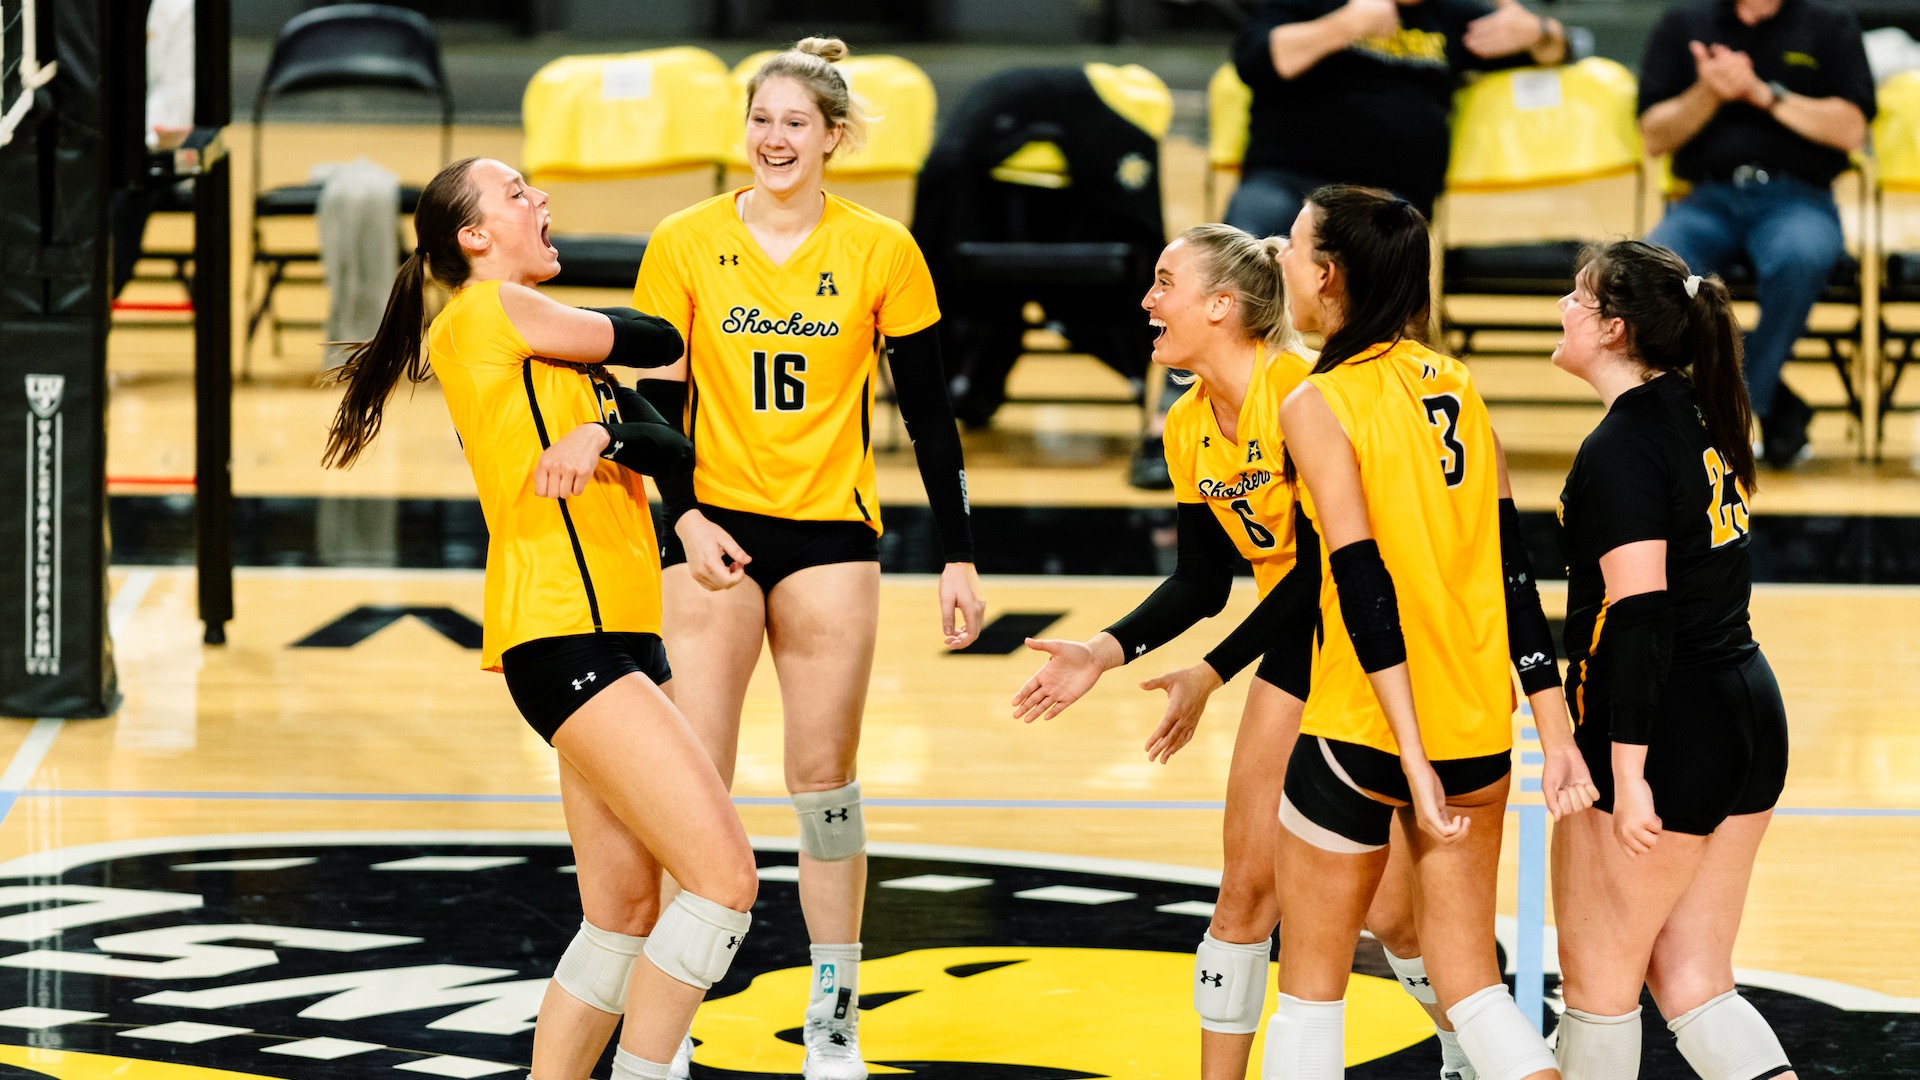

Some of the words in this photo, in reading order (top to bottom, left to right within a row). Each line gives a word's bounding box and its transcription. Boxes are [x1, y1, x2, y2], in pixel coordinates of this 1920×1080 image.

[721, 305, 840, 337] Shockers
[752, 350, 807, 413] 16
[1420, 391, 1466, 490] 3
[1198, 468, 1272, 498] Shockers
[1230, 498, 1276, 550] 6
